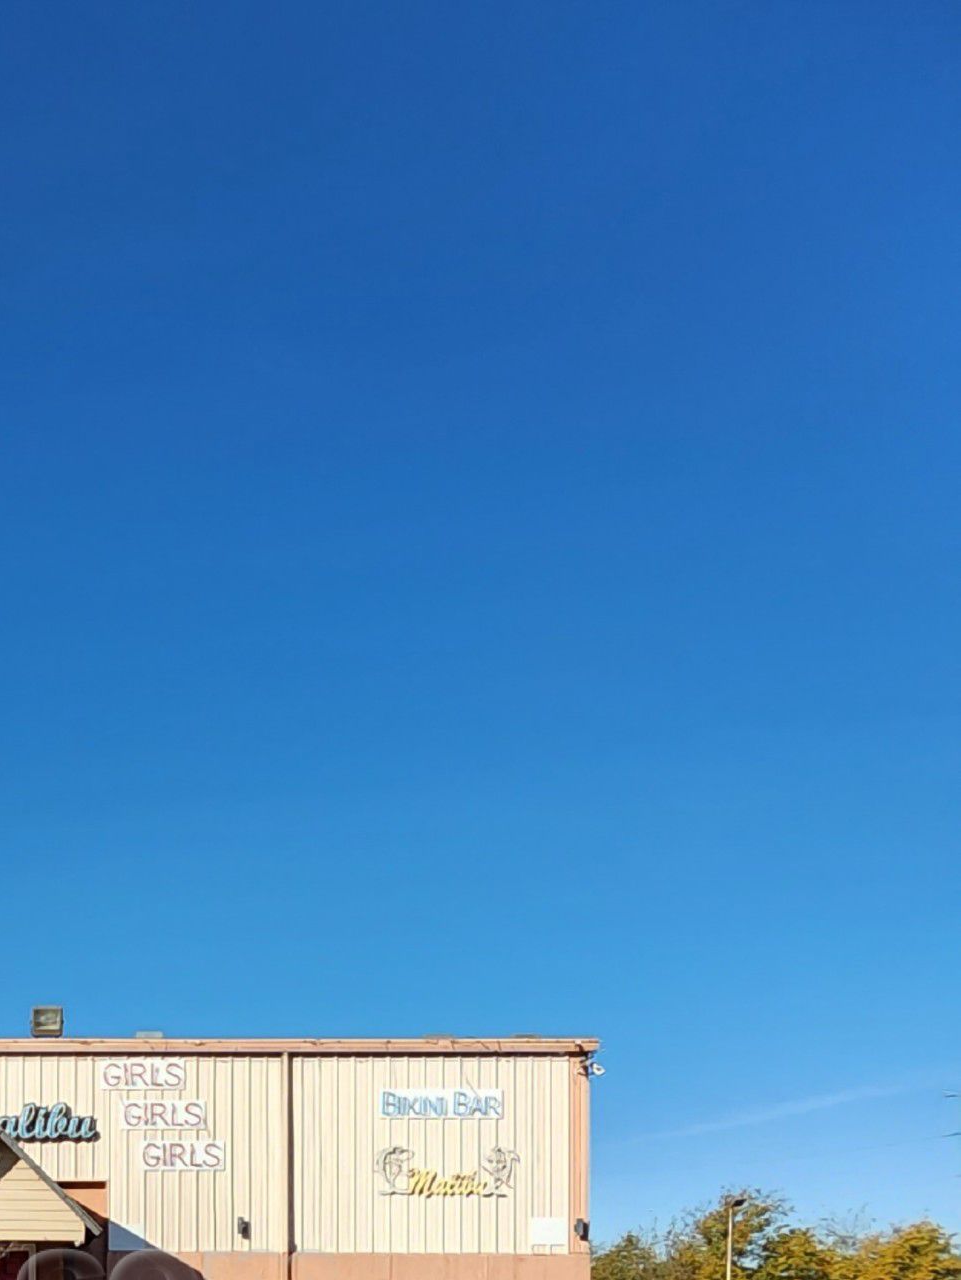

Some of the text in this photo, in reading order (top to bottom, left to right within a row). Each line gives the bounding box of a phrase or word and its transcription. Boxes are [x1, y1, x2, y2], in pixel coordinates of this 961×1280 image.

[103, 1062, 184, 1088] GIRLS
[123, 1101, 203, 1127] GIRLS
[454, 1091, 501, 1116] BAR
[142, 1142, 223, 1168] GIRLS
